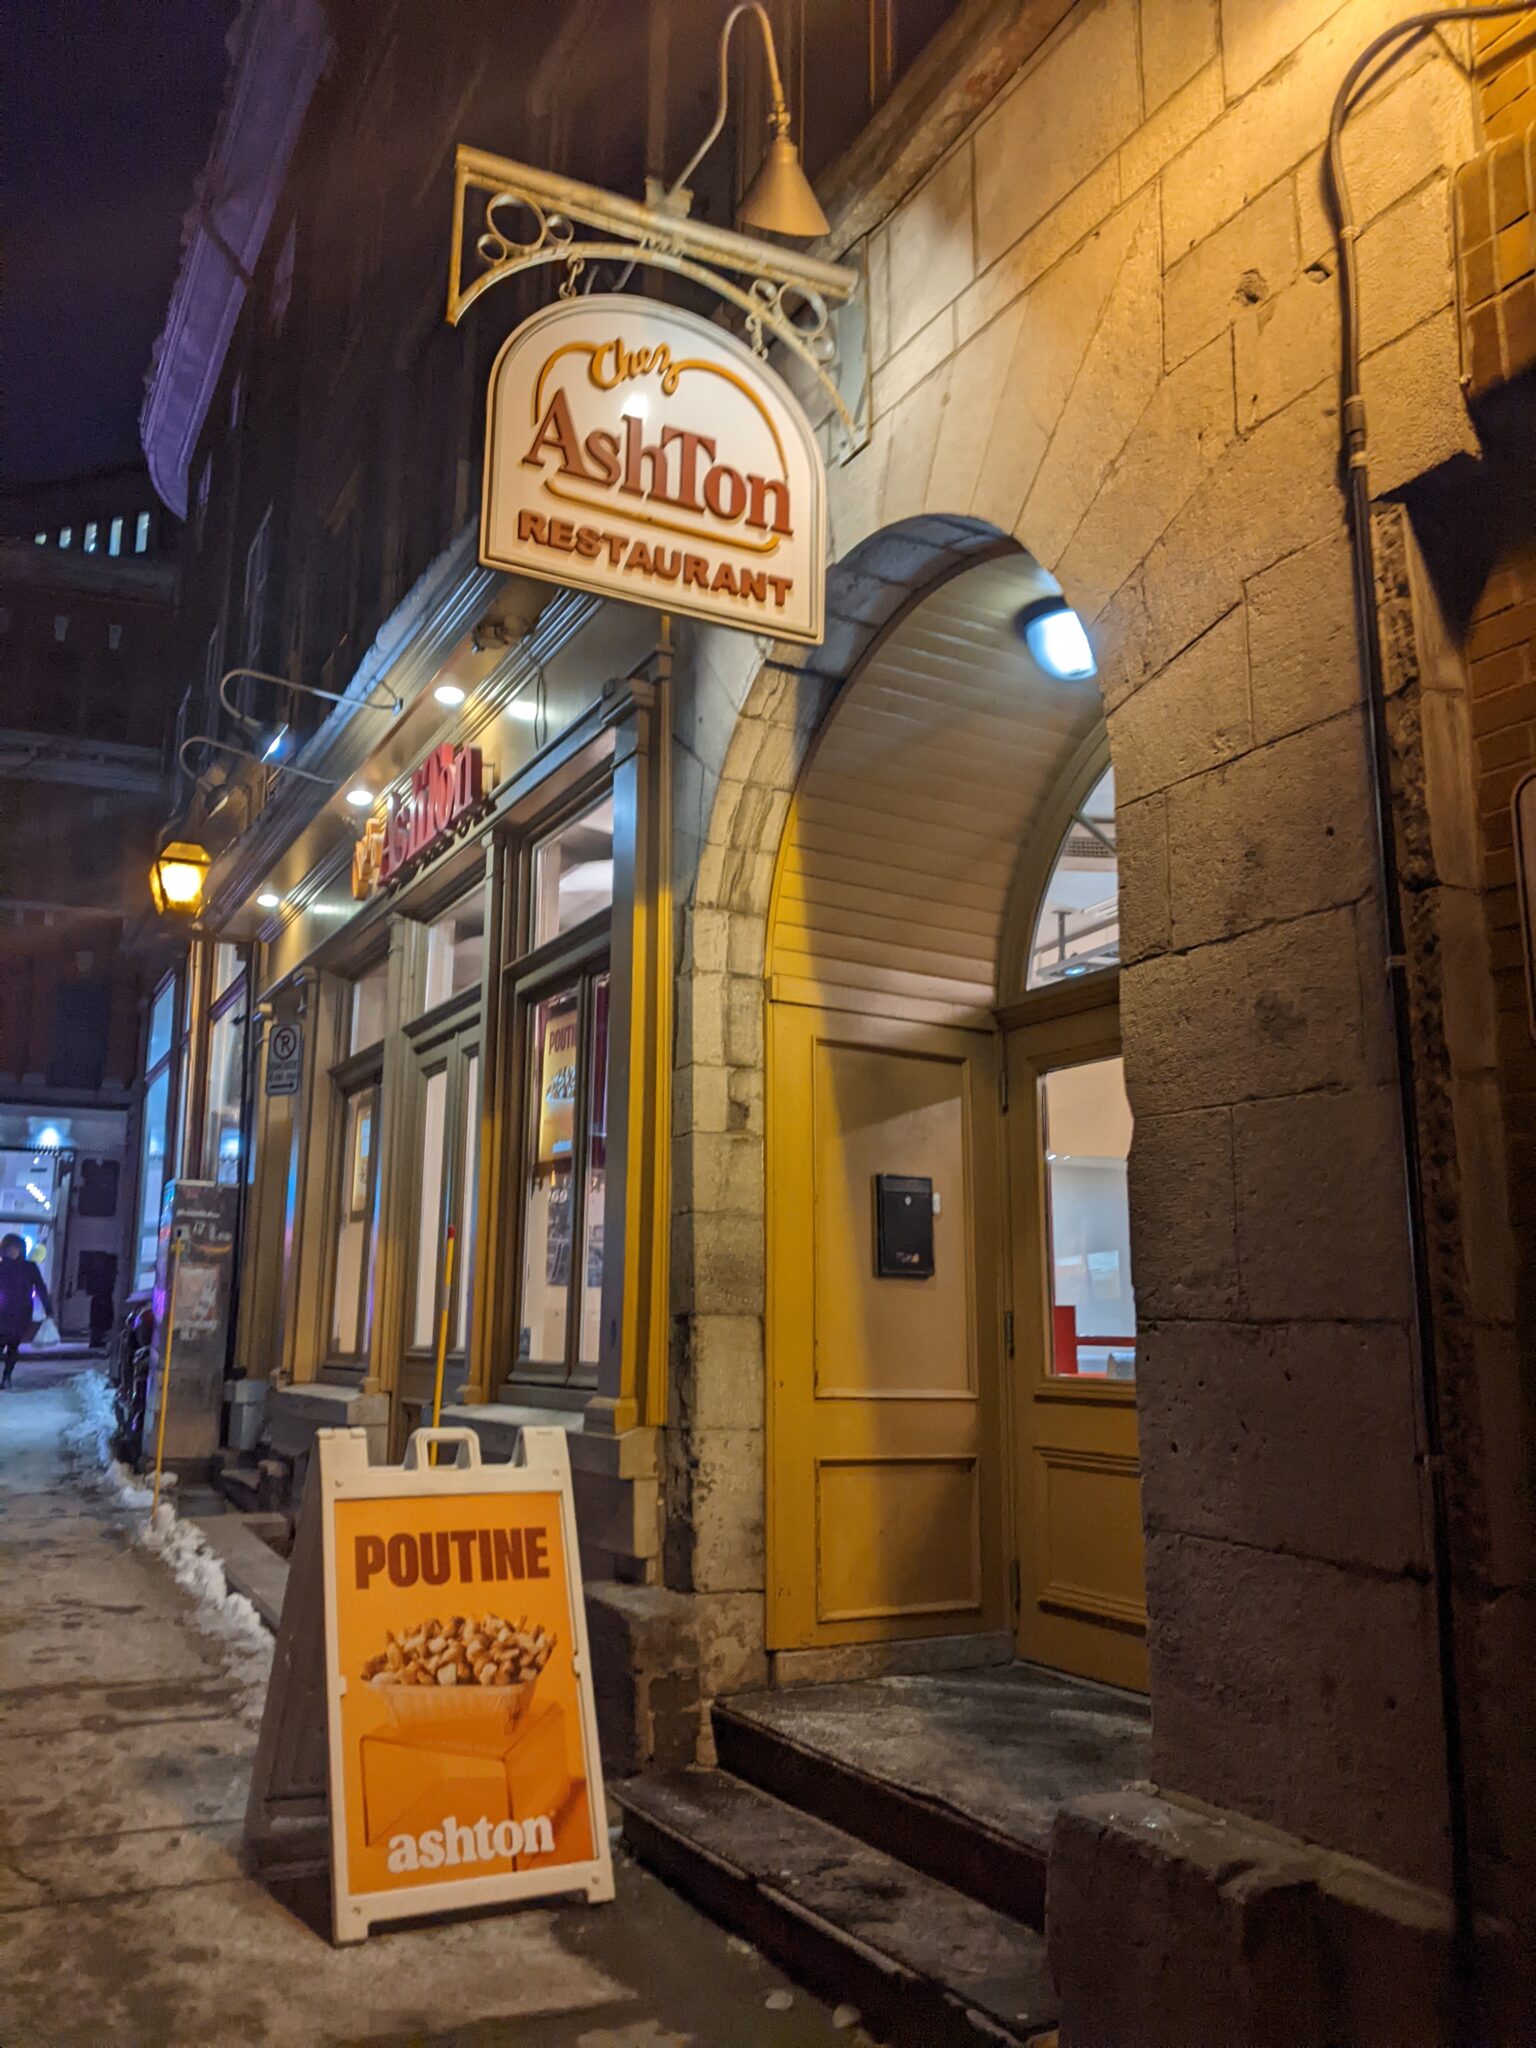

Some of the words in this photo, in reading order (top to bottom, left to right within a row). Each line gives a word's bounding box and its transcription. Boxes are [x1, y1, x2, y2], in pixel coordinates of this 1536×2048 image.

[587, 337, 680, 396] Chez
[517, 508, 794, 608] RESTAURANT
[548, 1023, 577, 1057] POUTI
[354, 1526, 551, 1590] POUTINE
[386, 1814, 556, 1874] ashton
